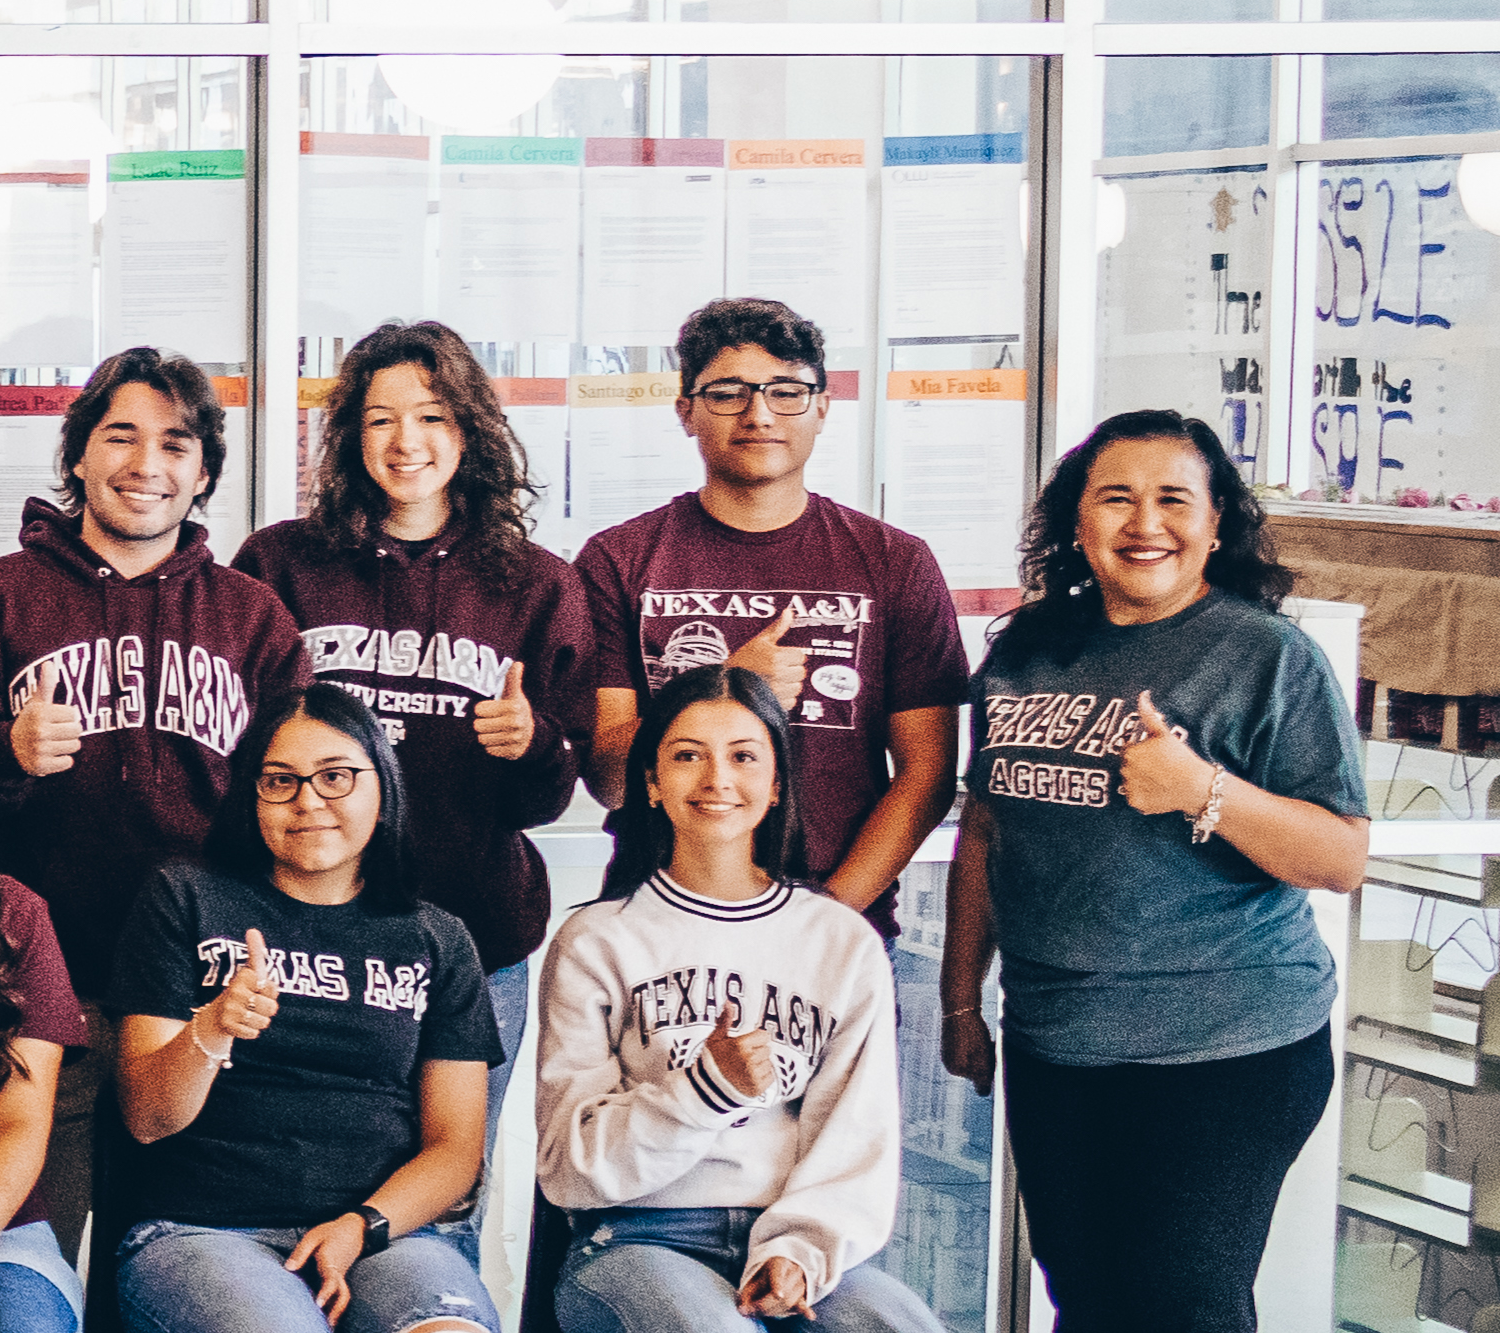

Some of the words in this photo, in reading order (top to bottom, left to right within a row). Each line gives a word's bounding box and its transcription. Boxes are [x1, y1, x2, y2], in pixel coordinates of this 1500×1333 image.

[444, 144, 502, 161] Camila
[508, 144, 575, 162] Cervera
[735, 148, 794, 165] Camila
[799, 149, 863, 165] Cervera
[178, 160, 219, 177] Ruiz
[577, 382, 646, 404] Santiago
[909, 377, 943, 394] Mia
[947, 377, 1002, 394] Favela
[641, 593, 776, 618] TEXAS
[787, 594, 875, 624] A&M
[301, 623, 423, 678] EXAS
[417, 631, 514, 701] A&M
[154, 638, 250, 758] A&M
[987, 757, 1110, 808] AGGIES
[630, 965, 745, 1047] TEXAS
